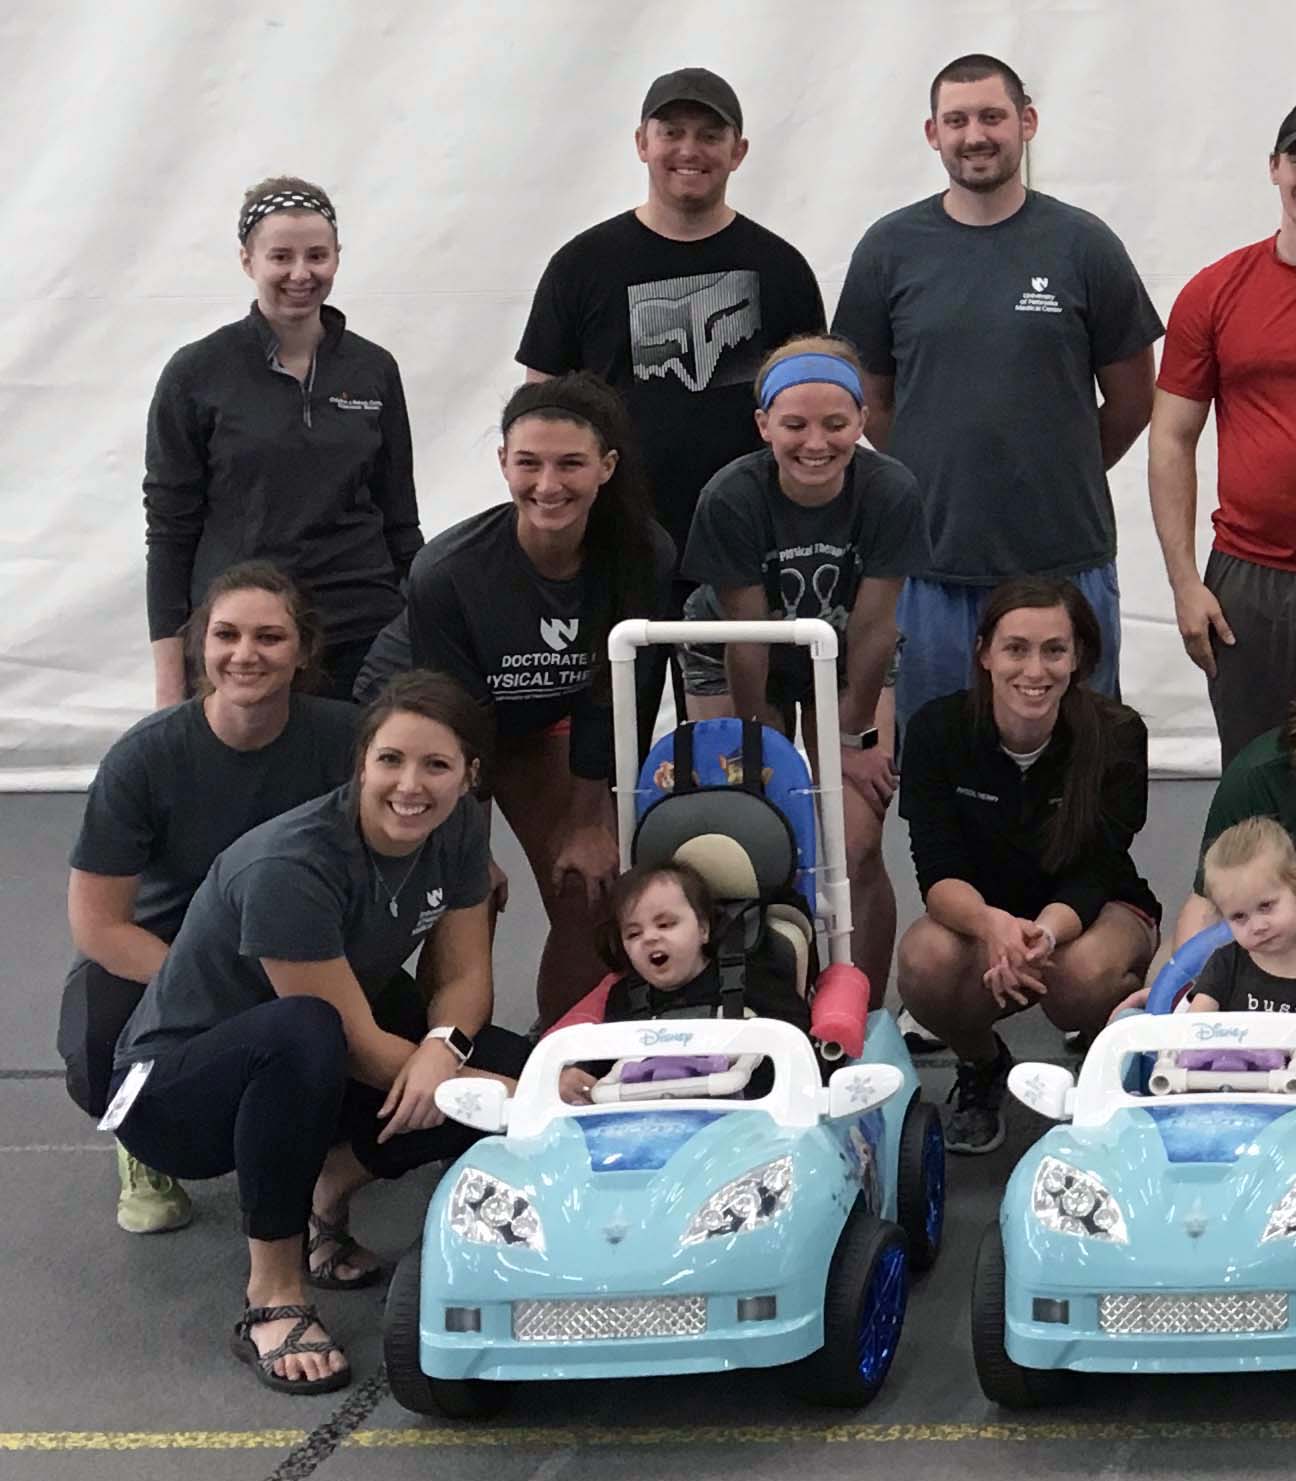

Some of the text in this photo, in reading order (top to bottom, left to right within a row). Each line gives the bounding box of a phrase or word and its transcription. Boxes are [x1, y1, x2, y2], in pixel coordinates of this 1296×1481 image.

[501, 652, 588, 668] DOCTORATE
[486, 671, 554, 689] YSICAL
[636, 1028, 693, 1047] Disney
[1192, 1022, 1248, 1043] Disney
